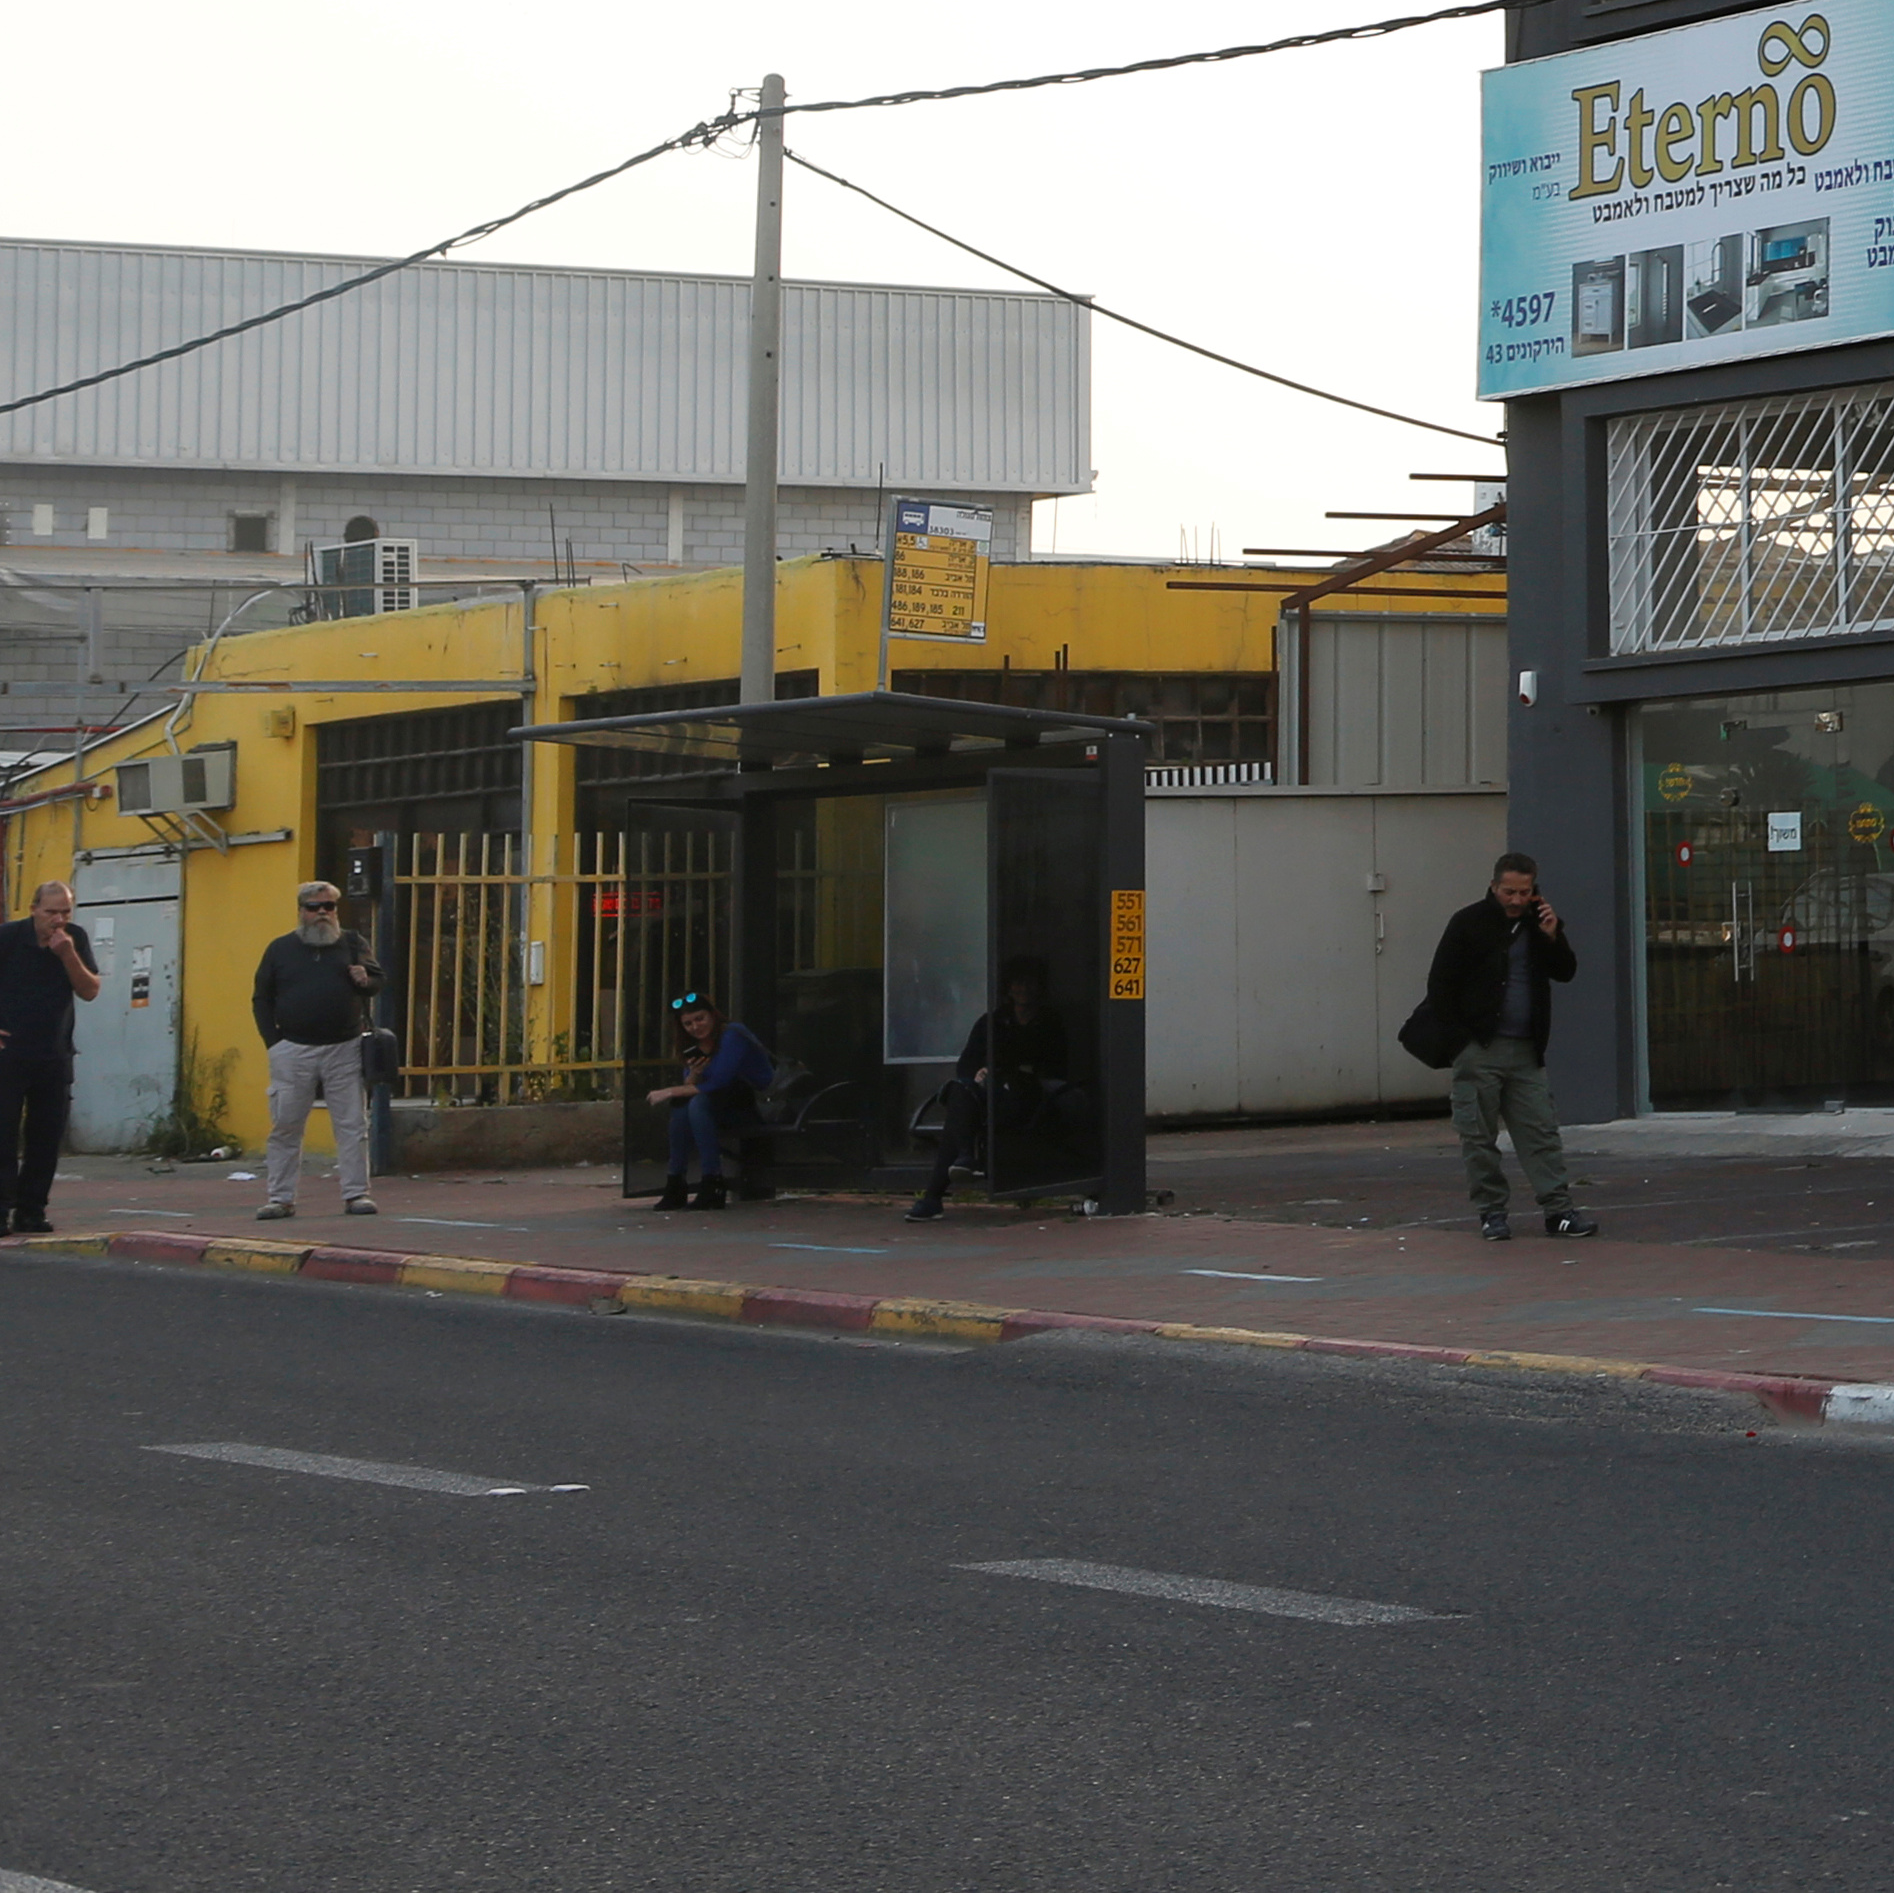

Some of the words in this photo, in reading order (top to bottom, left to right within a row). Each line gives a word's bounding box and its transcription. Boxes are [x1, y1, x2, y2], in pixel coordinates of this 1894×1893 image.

[1568, 73, 1836, 200] Eterno
[1489, 157, 1528, 185] ושיווק
[1530, 152, 1561, 174] ייבוא
[1787, 162, 1806, 186] כל
[1759, 171, 1782, 192] מה
[1814, 159, 1869, 192] ולאמבט
[1654, 180, 1704, 212] למטבח
[1709, 175, 1756, 207] שצריך
[1593, 192, 1650, 224] ולאמבט
[1486, 344, 1503, 364] 43
[1507, 336, 1564, 363] הירקונים
[1116, 893, 1142, 910] 551
[1116, 914, 1142, 932] 561
[1116, 936, 1142, 953] 571
[1114, 957, 1141, 974] 627
[1114, 979, 1140, 996] 641
